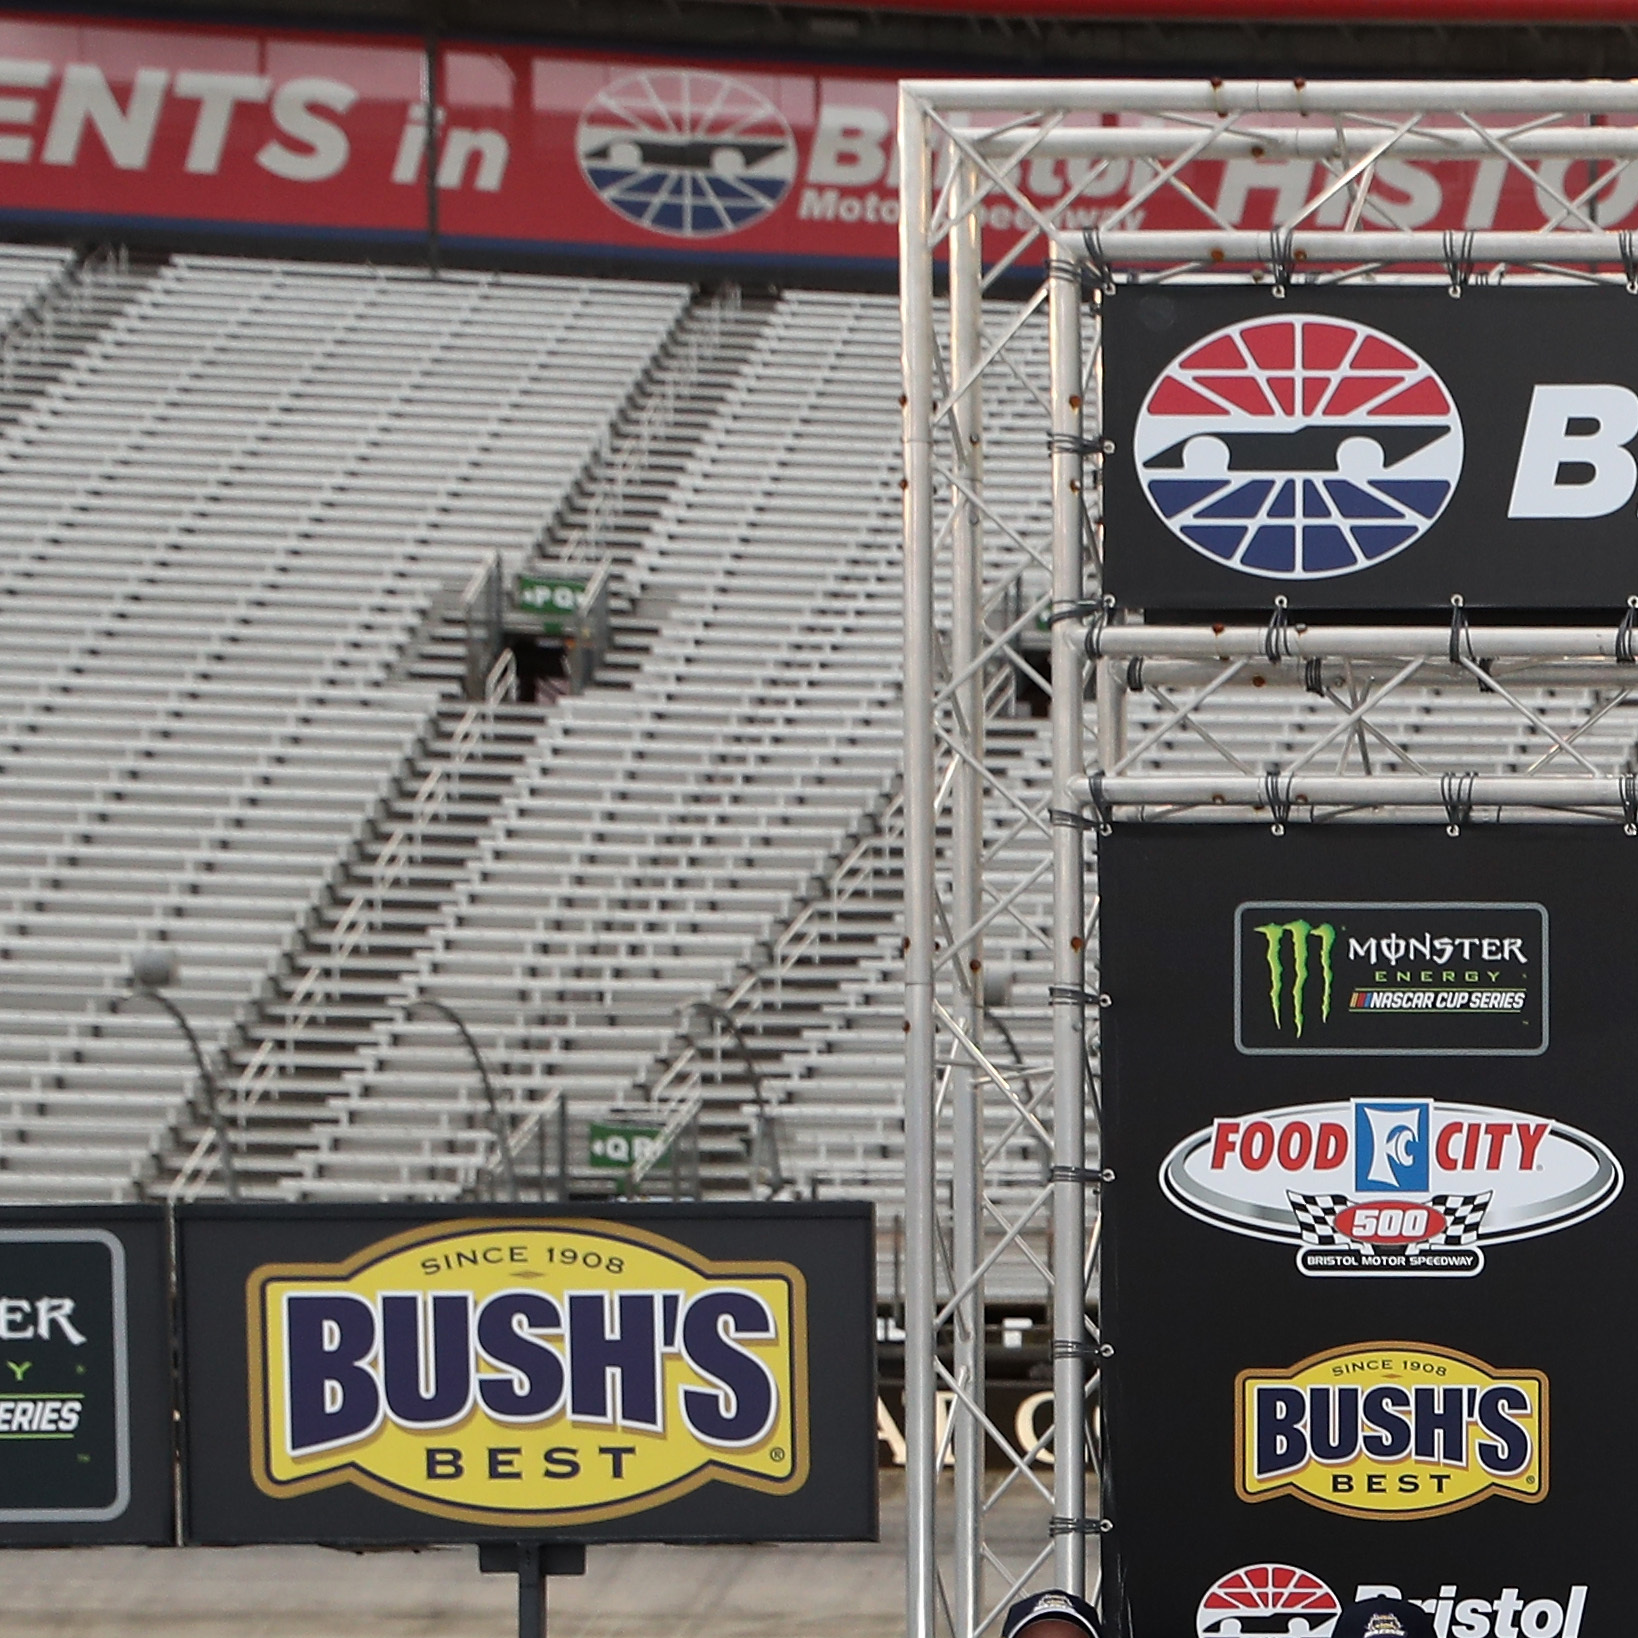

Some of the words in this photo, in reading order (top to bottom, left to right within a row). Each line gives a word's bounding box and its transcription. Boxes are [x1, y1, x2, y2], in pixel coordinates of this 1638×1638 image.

[391, 104, 510, 192] in
[1348, 932, 1528, 966] MONSTER
[1375, 970, 1500, 983] ENERGY
[1369, 992, 1434, 1009] NASCAR
[1436, 992, 1470, 1009] CUP
[1471, 991, 1526, 1009] SERIES
[1210, 1121, 1349, 1172] FOOD
[1436, 1122, 1549, 1172] CITY
[1352, 1208, 1428, 1238] 500
[419, 1245, 529, 1277] SINCE
[546, 1245, 627, 1276] 1908
[1307, 1254, 1358, 1267] BRISTOL
[1361, 1254, 1406, 1267] MOTOR
[1410, 1254, 1475, 1267] SPEEDWAY
[282, 1287, 780, 1460] BUSH'S
[1332, 1359, 1393, 1378] SINCE
[1401, 1360, 1447, 1377] 1908
[1253, 1384, 1533, 1481] BUSH'S
[424, 1446, 637, 1480] BEST
[1332, 1474, 1451, 1494] BEST
